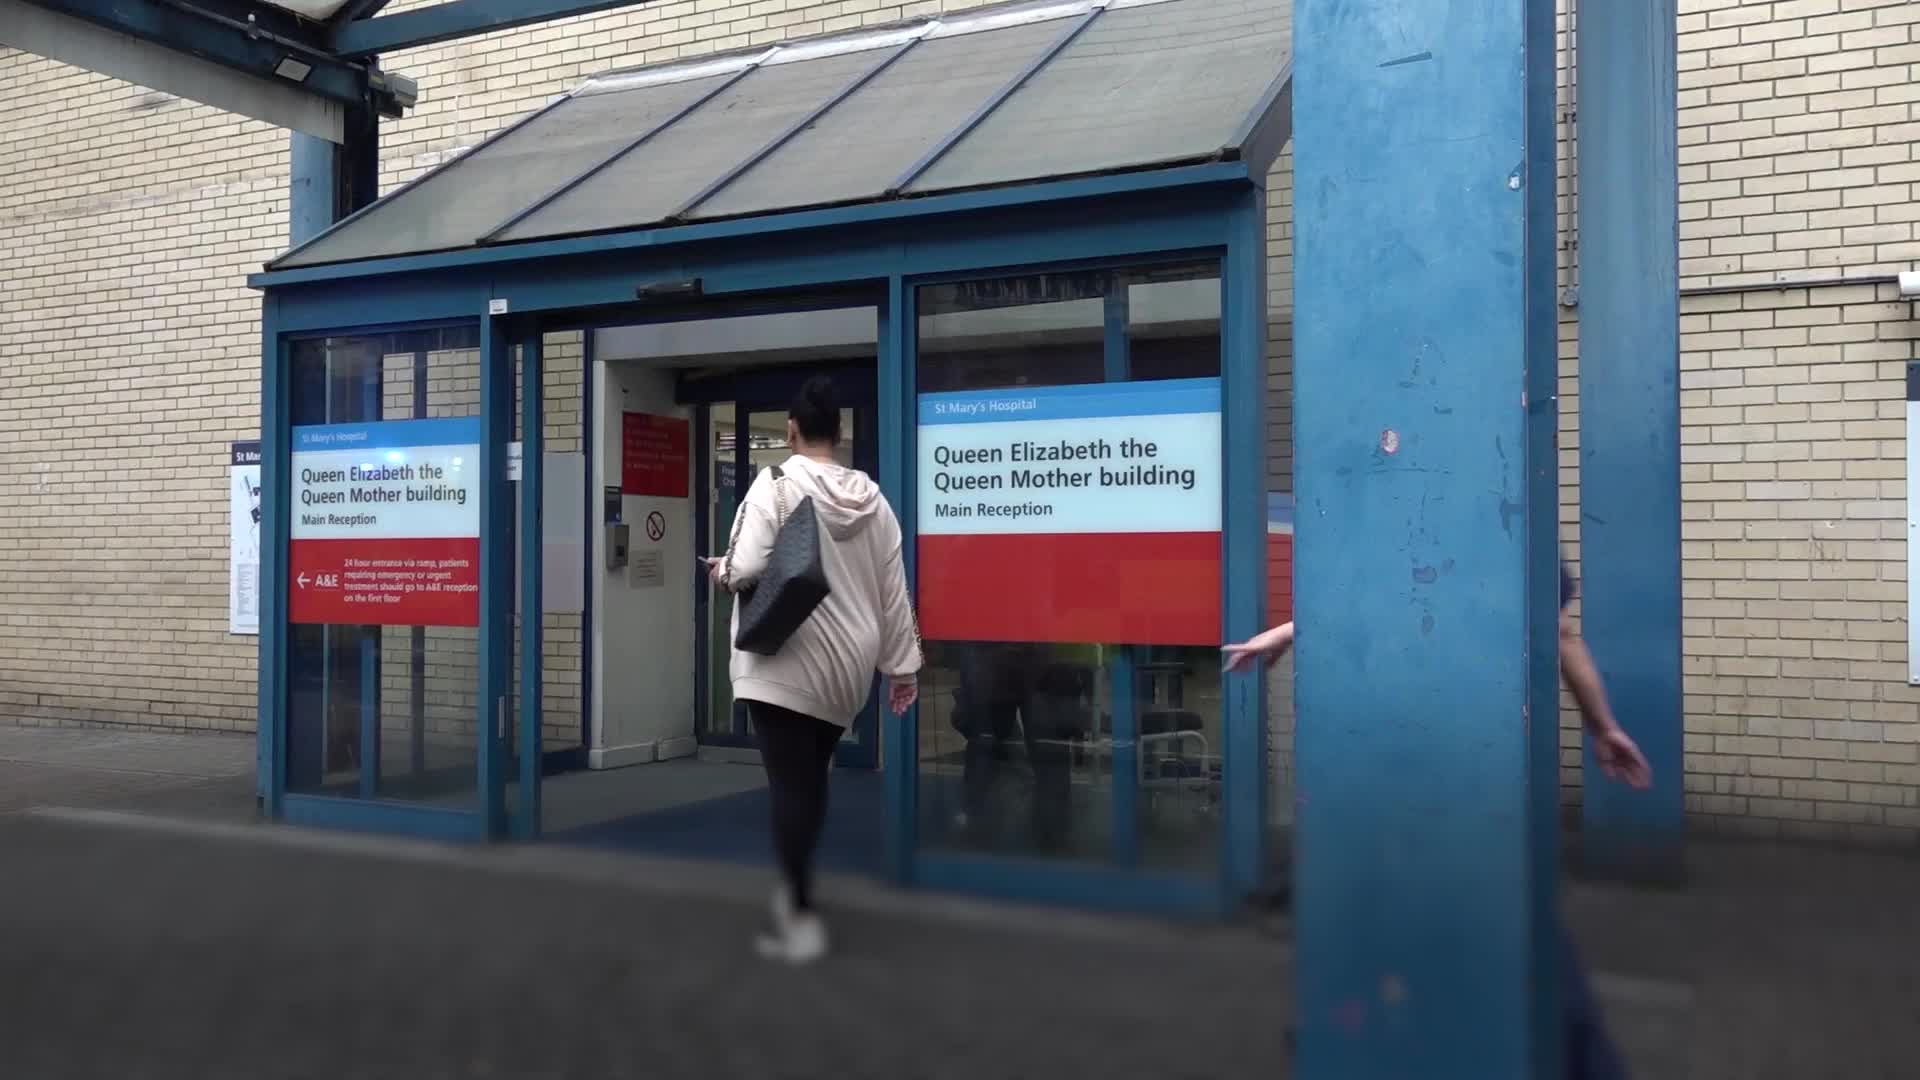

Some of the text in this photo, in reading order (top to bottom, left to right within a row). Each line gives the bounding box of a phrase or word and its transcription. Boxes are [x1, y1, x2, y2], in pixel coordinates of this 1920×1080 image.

[935, 403, 947, 414] St
[989, 398, 1036, 413] Hospital
[303, 434, 311, 443] St
[336, 431, 368, 442] Hospital
[236, 452, 244, 462] St
[934, 437, 1158, 467] Queen Elizabeth the
[302, 462, 443, 484] Queen Elizabeth the
[934, 465, 1195, 493] Queen Mother building
[302, 485, 466, 505] Queen Mother building
[935, 501, 1053, 519] Main Reception
[302, 513, 377, 528] Main Reception
[354, 559, 371, 567] hour
[439, 559, 469, 568] patients
[315, 574, 338, 587] A&E
[344, 572, 376, 580] requiring
[377, 572, 415, 580] emergency
[427, 572, 451, 580] urgent
[380, 583, 403, 591] should
[405, 584, 415, 593] go
[426, 583, 442, 591] A&E
[443, 584, 478, 593] reception
[354, 594, 366, 602] the
[367, 594, 382, 602] first
[383, 594, 401, 602] floor
